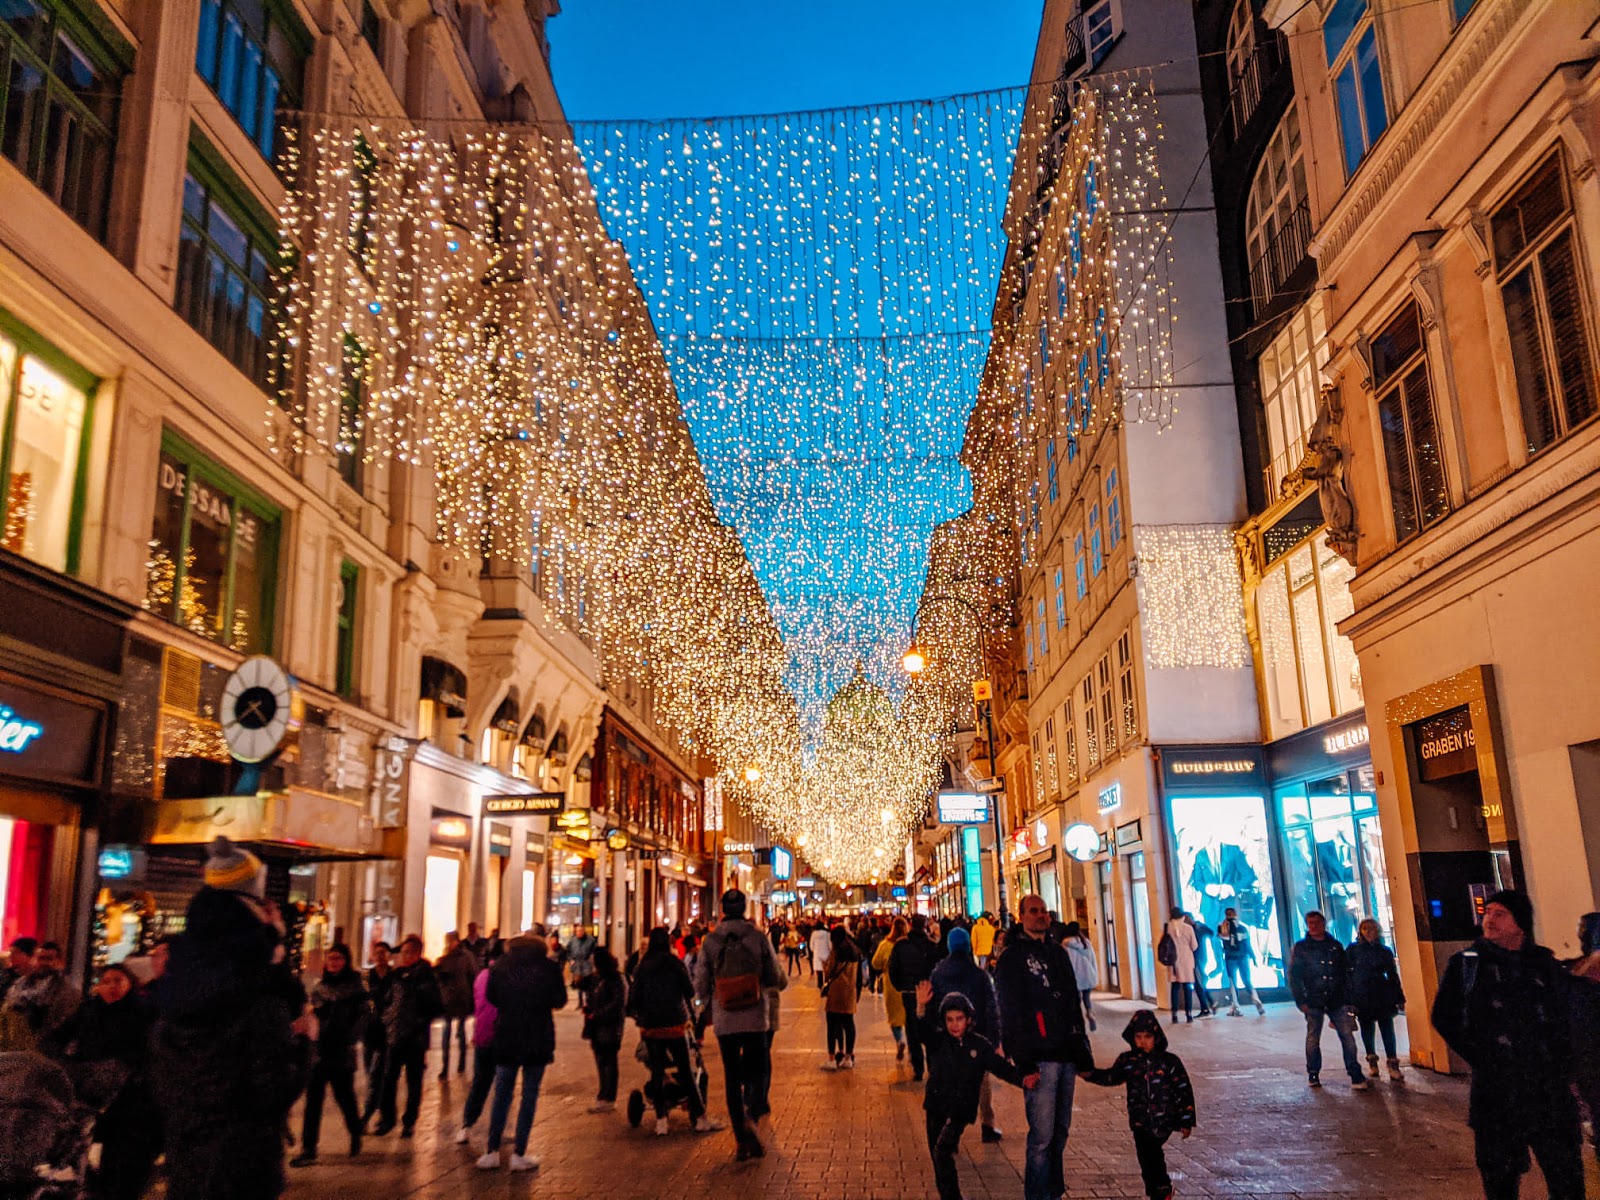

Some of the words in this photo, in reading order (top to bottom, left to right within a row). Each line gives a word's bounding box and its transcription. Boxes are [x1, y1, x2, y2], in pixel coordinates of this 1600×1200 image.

[1421, 732, 1463, 760] GRABEN
[1463, 729, 1476, 748] 19
[723, 842, 756, 852] GUCCI
